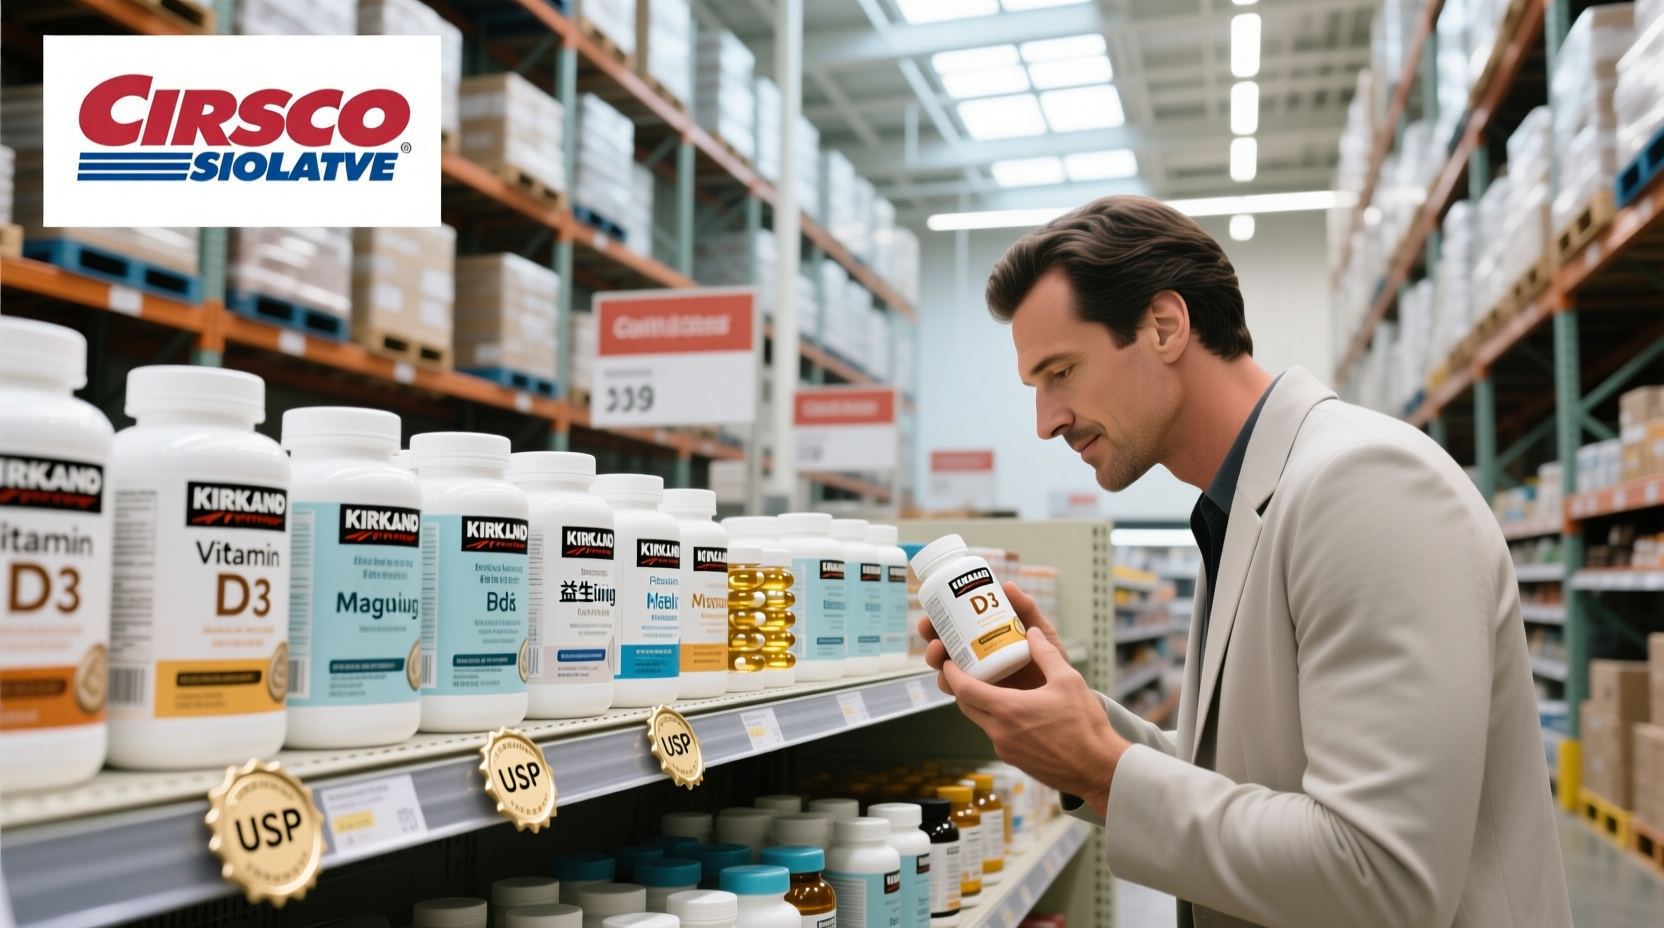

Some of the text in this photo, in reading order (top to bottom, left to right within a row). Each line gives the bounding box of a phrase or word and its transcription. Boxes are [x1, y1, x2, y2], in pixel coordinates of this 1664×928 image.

[196, 540, 280, 567] Vitamin
[8, 562, 81, 614] D3
[216, 573, 271, 617] D3
[969, 592, 999, 615] D3
[652, 733, 691, 756] USP
[498, 762, 541, 792] USP
[235, 808, 302, 851] USP
